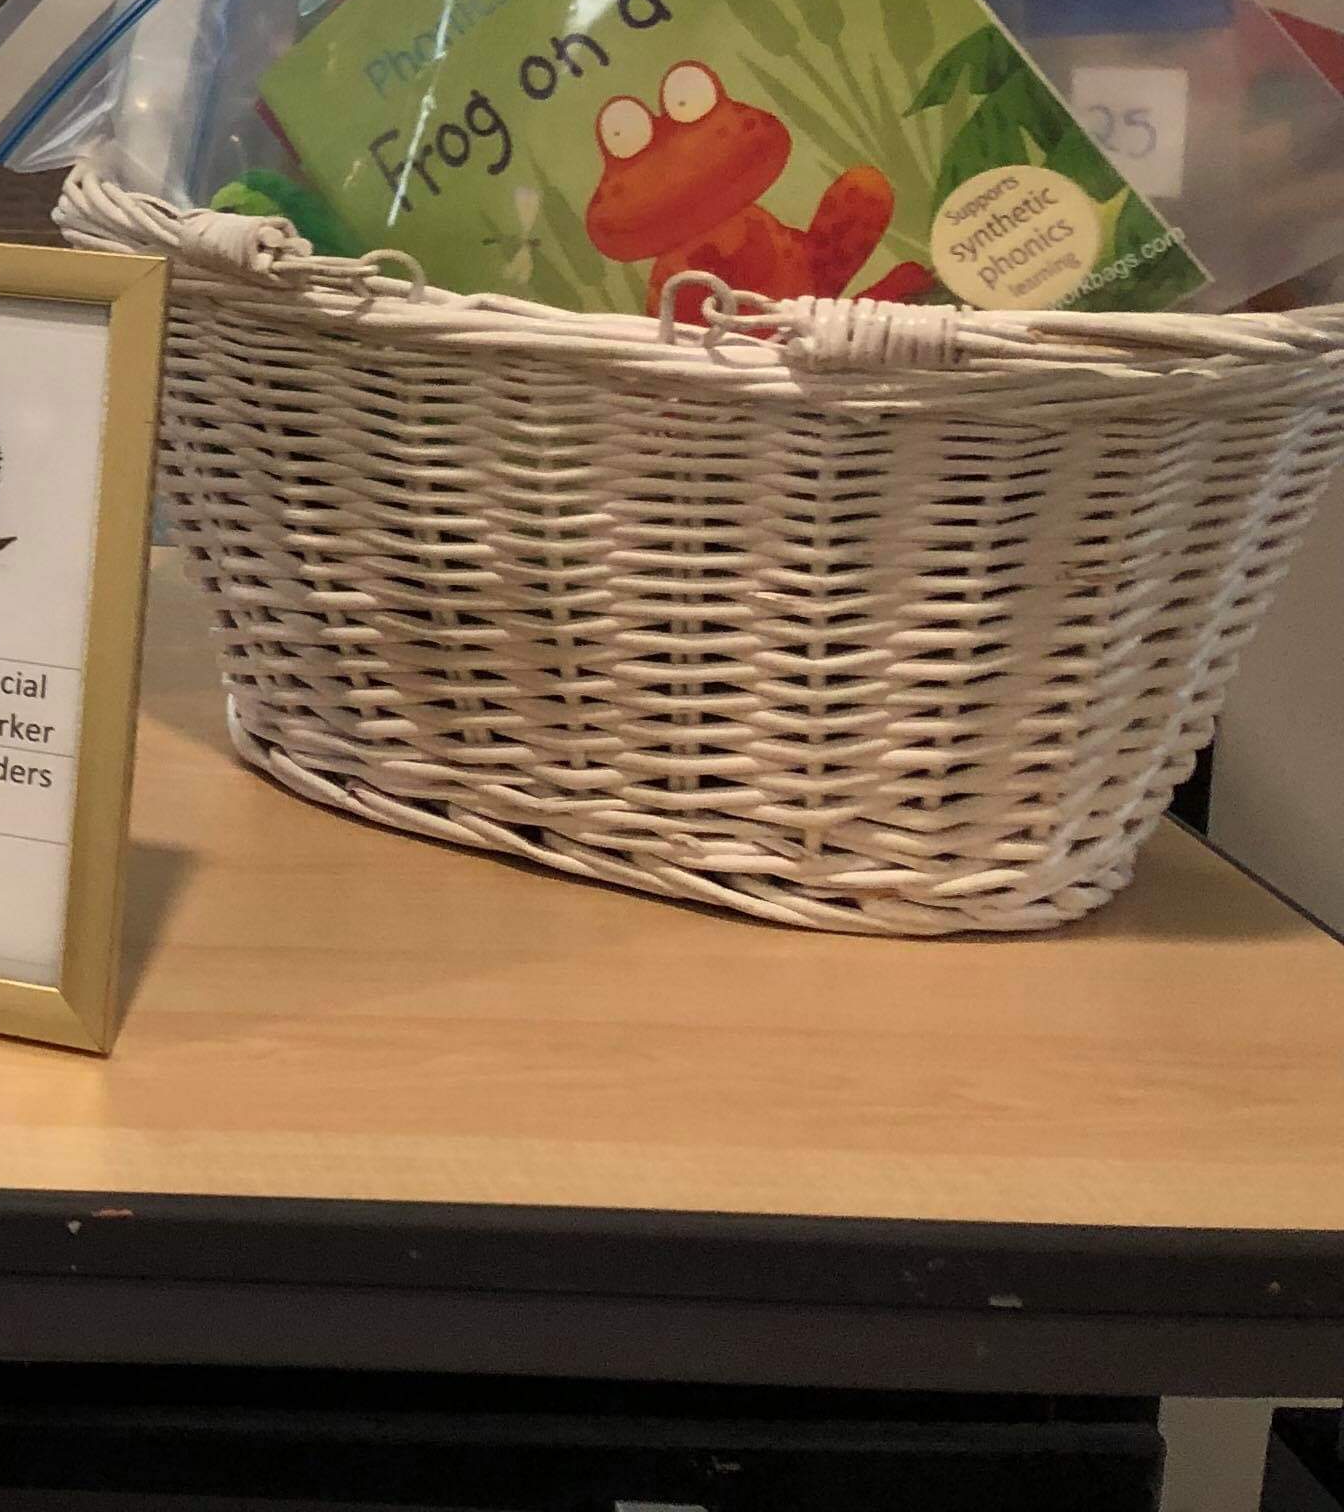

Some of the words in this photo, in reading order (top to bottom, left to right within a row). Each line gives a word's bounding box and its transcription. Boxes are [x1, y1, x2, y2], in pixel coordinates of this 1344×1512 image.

[369, 89, 513, 212] Frog
[519, 31, 611, 101] on
[944, 175, 1020, 227] Supports
[948, 187, 1060, 264] synthetic
[976, 218, 1075, 291] phonics
[1008, 250, 1082, 298] learning
